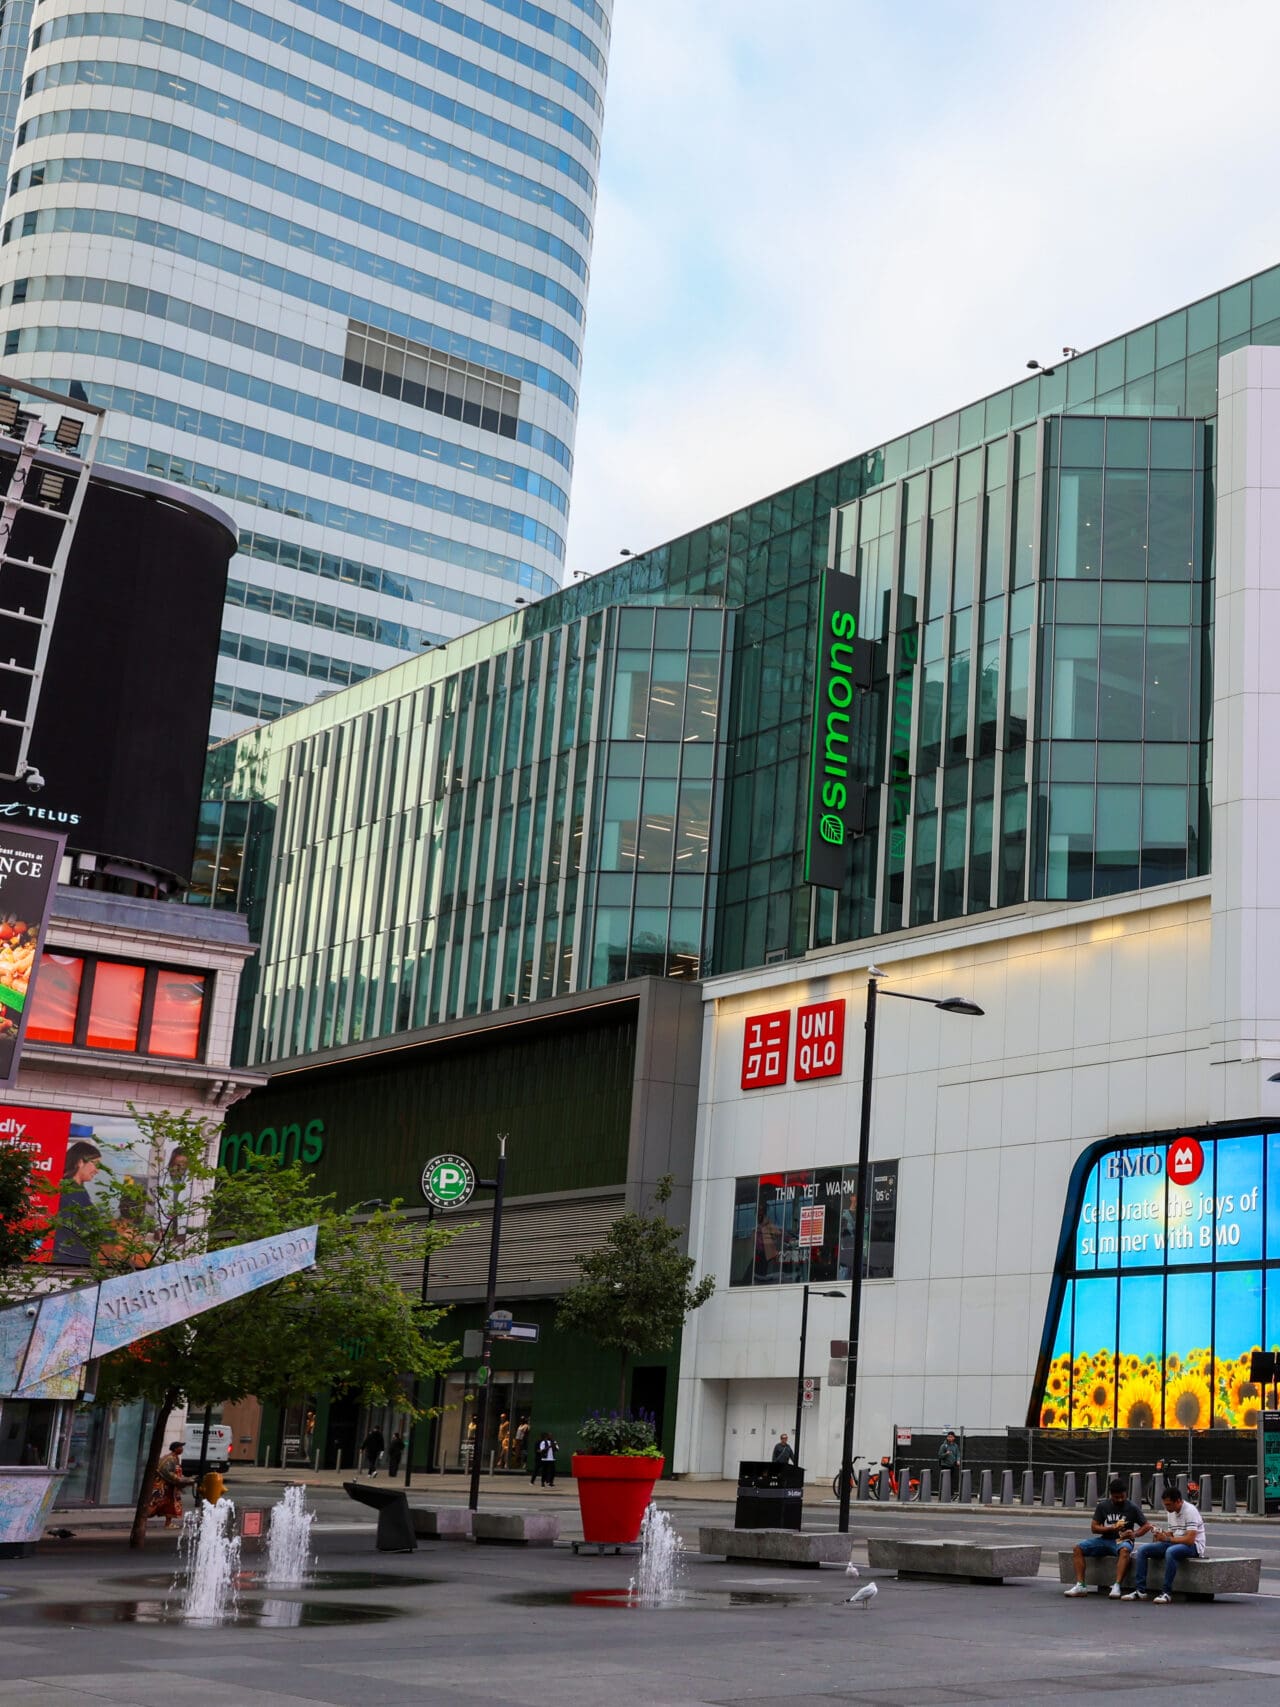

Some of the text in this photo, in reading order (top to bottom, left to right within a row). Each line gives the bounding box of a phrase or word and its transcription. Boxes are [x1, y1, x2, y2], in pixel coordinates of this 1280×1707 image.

[822, 610, 856, 810] simons
[27, 806, 79, 824] TELUS
[801, 1010, 834, 1040] UNI
[800, 1041, 836, 1074] QLO
[425, 1157, 472, 1181] MUNICIPAL
[439, 1168, 460, 1189] P
[1106, 1153, 1162, 1179] BMO
[775, 1180, 855, 1200] THIN YET WARM
[1082, 1186, 1259, 1224] Celebrate the joys of
[1081, 1223, 1240, 1255] summer with BMO
[102, 1235, 310, 1320] Visitor Information
